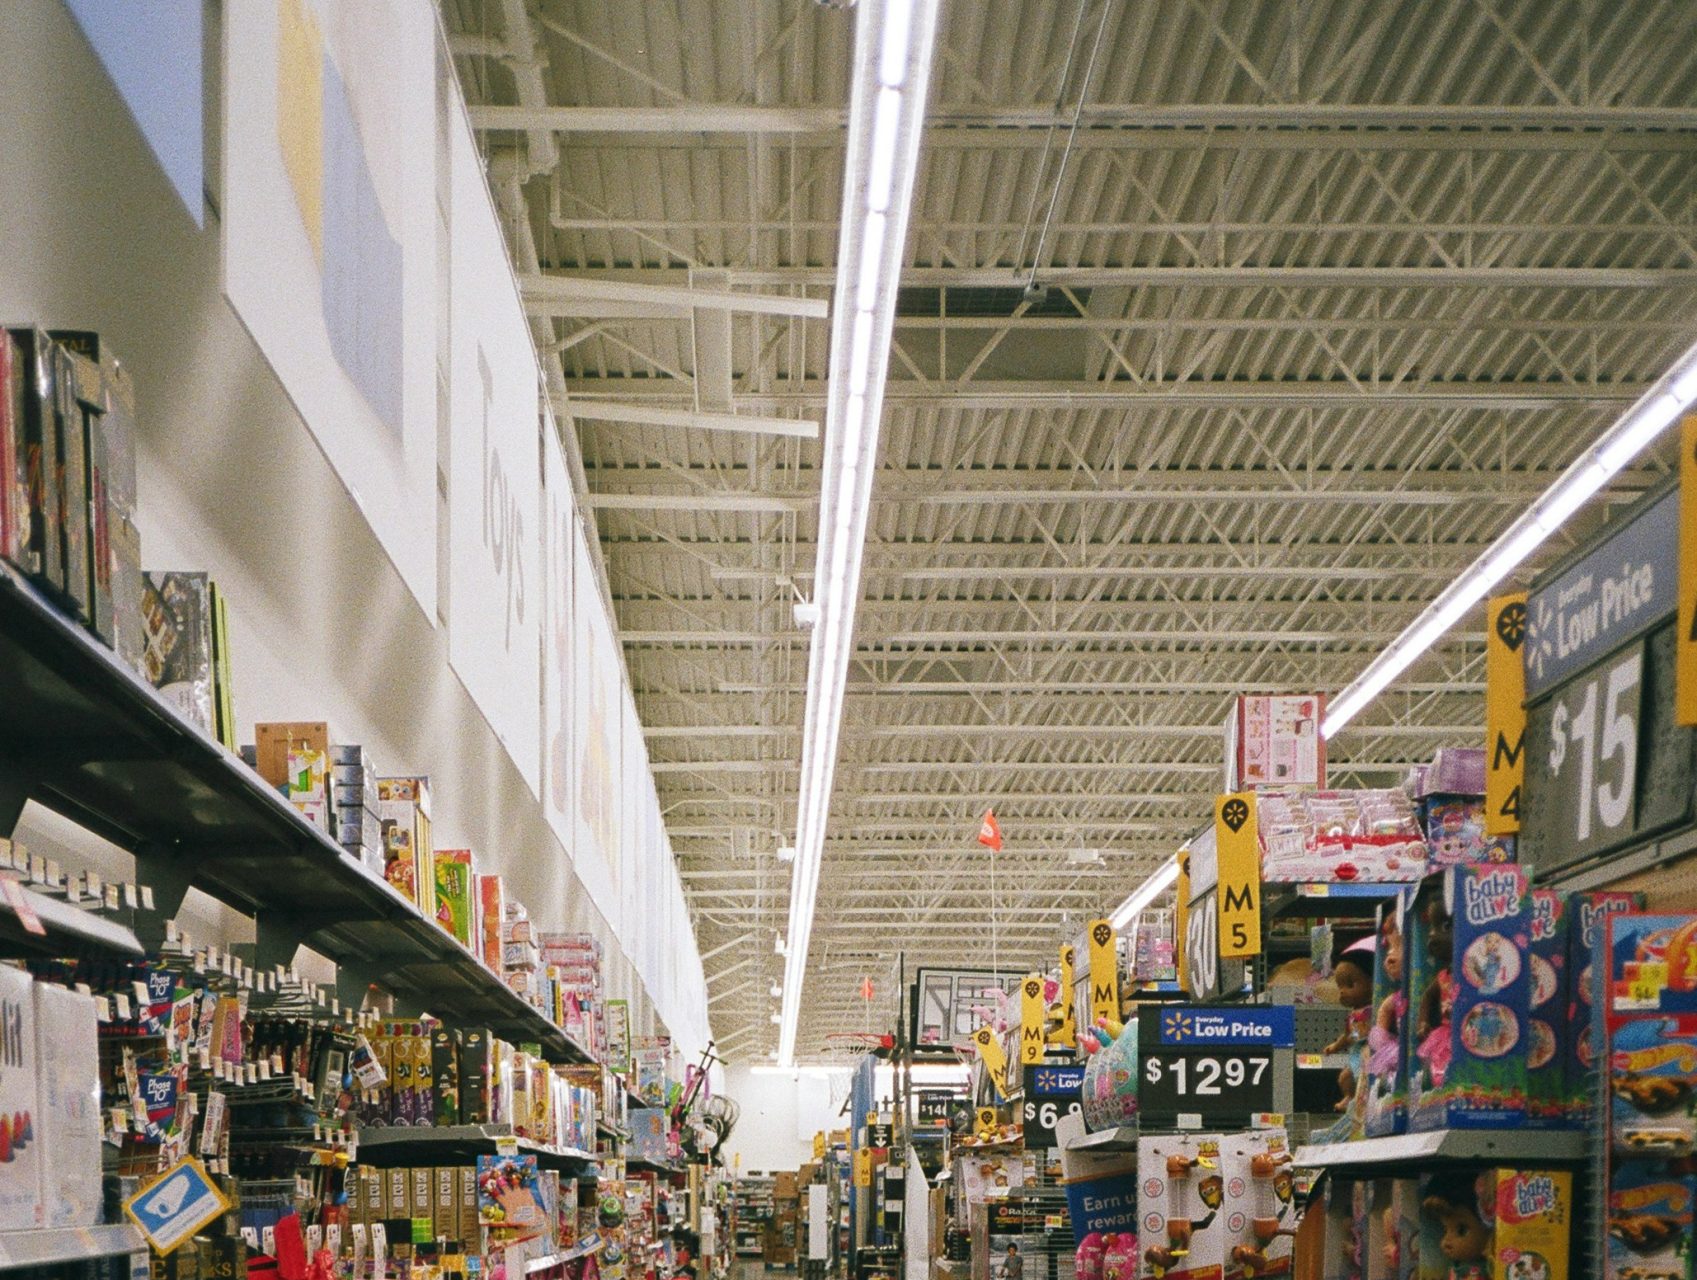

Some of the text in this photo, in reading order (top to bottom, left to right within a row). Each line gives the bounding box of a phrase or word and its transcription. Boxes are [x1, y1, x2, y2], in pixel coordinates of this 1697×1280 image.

[1555, 560, 1653, 660] Low Price
[1493, 727, 1526, 772] M
[1550, 652, 1644, 842] $15
[1500, 785, 1521, 823] 4
[1464, 872, 1516, 903] baby
[1223, 883, 1254, 913] M
[1466, 893, 1521, 925] alive
[1232, 923, 1247, 949] 5
[150, 972, 171, 989] Phase
[153, 985, 168, 997] 10
[1094, 983, 1113, 1003] M
[1194, 1016, 1224, 1025] Everyday
[1194, 1022, 1272, 1038] Low Price
[1023, 1026, 1041, 1041] M
[1027, 1045, 1037, 1061] 9
[148, 1078, 172, 1093] Phase
[1058, 1077, 1083, 1089] Low
[151, 1089, 168, 1102] 10
[1516, 1176, 1553, 1200] baby
[1083, 1194, 1122, 1213] Earn
[1518, 1194, 1554, 1218] alive
